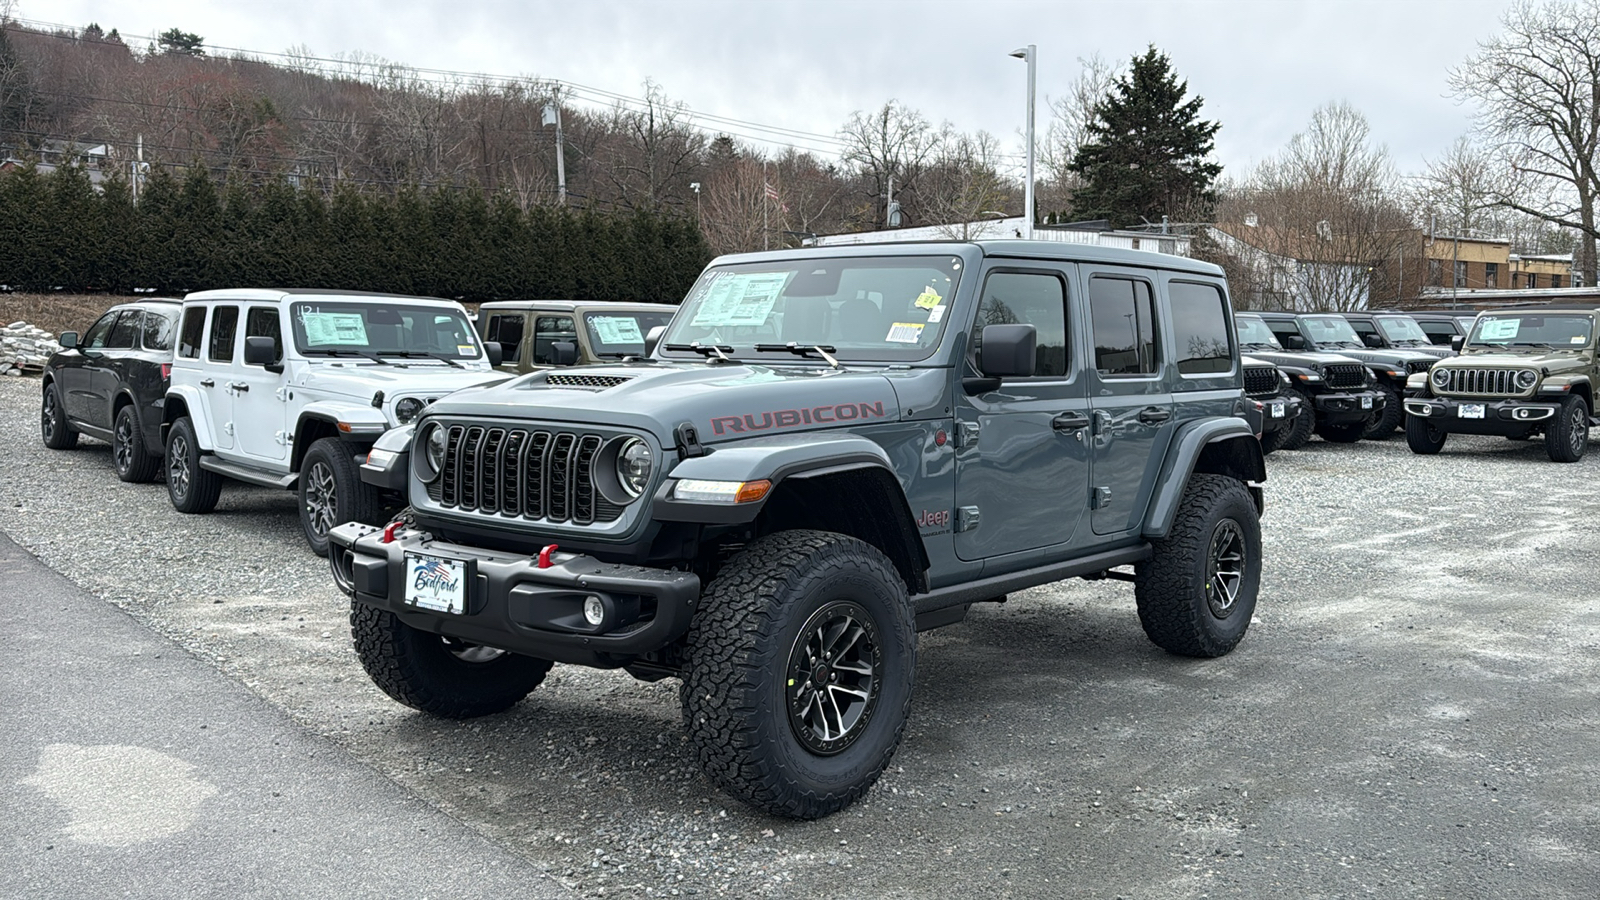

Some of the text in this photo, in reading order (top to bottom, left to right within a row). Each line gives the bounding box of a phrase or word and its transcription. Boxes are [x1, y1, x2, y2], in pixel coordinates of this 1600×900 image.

[710, 401, 885, 436] RUBICON
[917, 509, 949, 528] Jeep
[414, 565, 459, 597] Bedford
